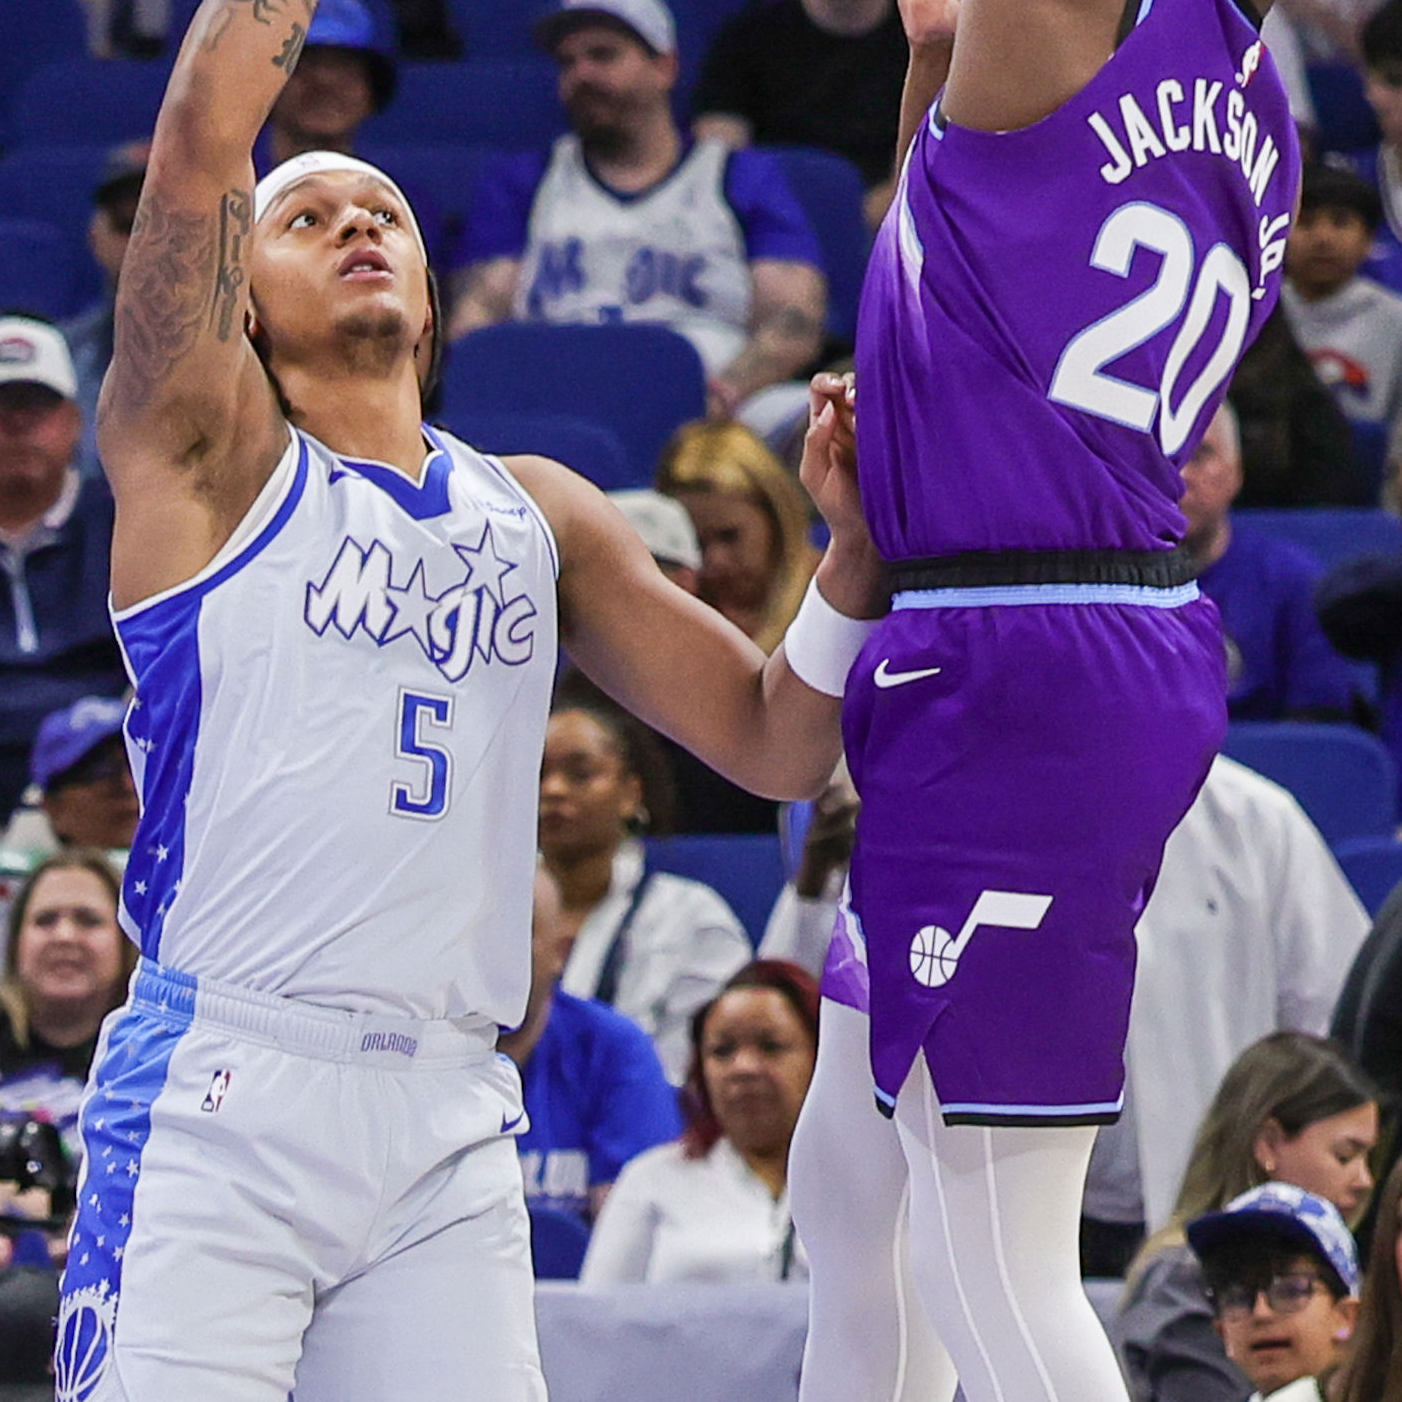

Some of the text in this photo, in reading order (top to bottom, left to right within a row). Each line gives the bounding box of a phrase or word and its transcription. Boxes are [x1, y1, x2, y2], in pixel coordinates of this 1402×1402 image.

[1087, 77, 1290, 300] JACKSON JR.
[1048, 200, 1251, 457] 20
[388, 685, 455, 822] 5
[360, 1031, 418, 1058] ORLANDO
